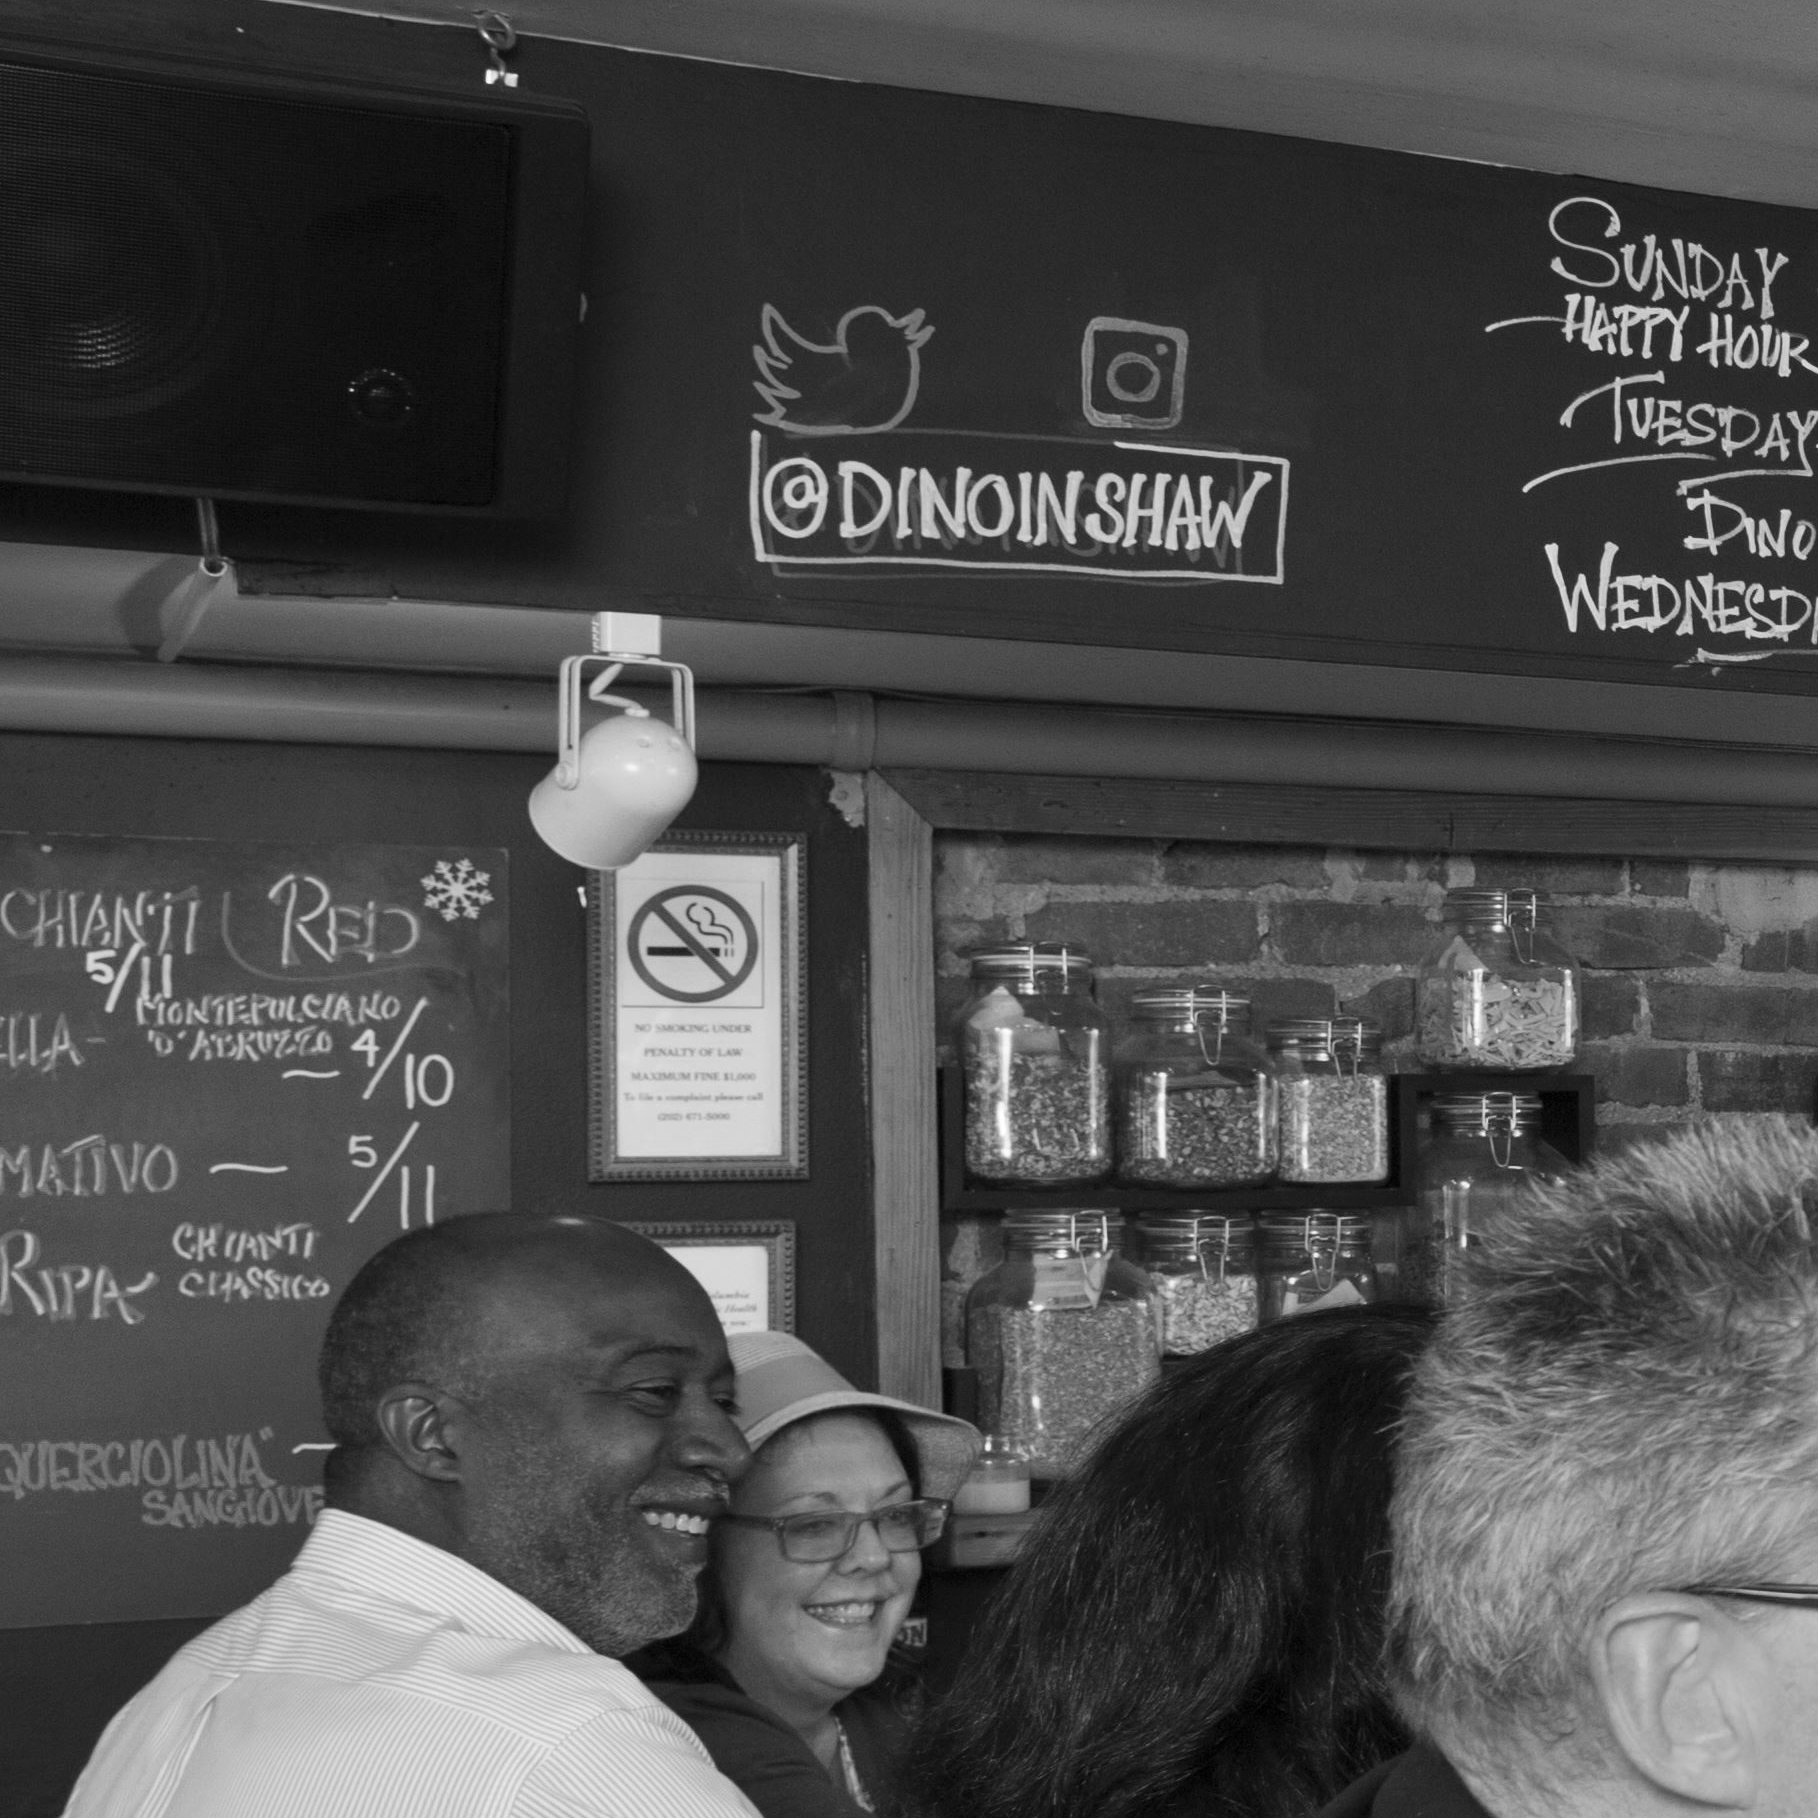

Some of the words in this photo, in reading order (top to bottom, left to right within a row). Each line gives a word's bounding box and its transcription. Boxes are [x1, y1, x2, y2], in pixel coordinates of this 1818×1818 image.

[1548, 196, 1789, 319] SUNDAY
[1563, 293, 1691, 361] HAPPY
[762, 456, 1272, 550] @DINOINSHAW
[1683, 490, 1816, 559] DINO
[267, 872, 422, 967] RED
[136, 991, 402, 1027] MONTEPULCIANO
[634, 1023, 652, 1033] NO
[655, 1023, 710, 1034] SMOKING
[712, 1024, 752, 1034] UNDER
[643, 1047, 697, 1058] PENALTY
[697, 1047, 715, 1058] OF
[717, 1047, 743, 1058] LAW
[630, 1071, 692, 1082] MAXIMUM
[693, 1071, 721, 1082] FINE
[664, 1092, 713, 1103] complaint
[714, 1092, 745, 1103] please
[0, 1134, 180, 1197] MATIVO
[172, 1221, 323, 1265] CHIANTI
[176, 1266, 333, 1302] CLASSICO
[140, 1483, 326, 1530] SANGIOVE
